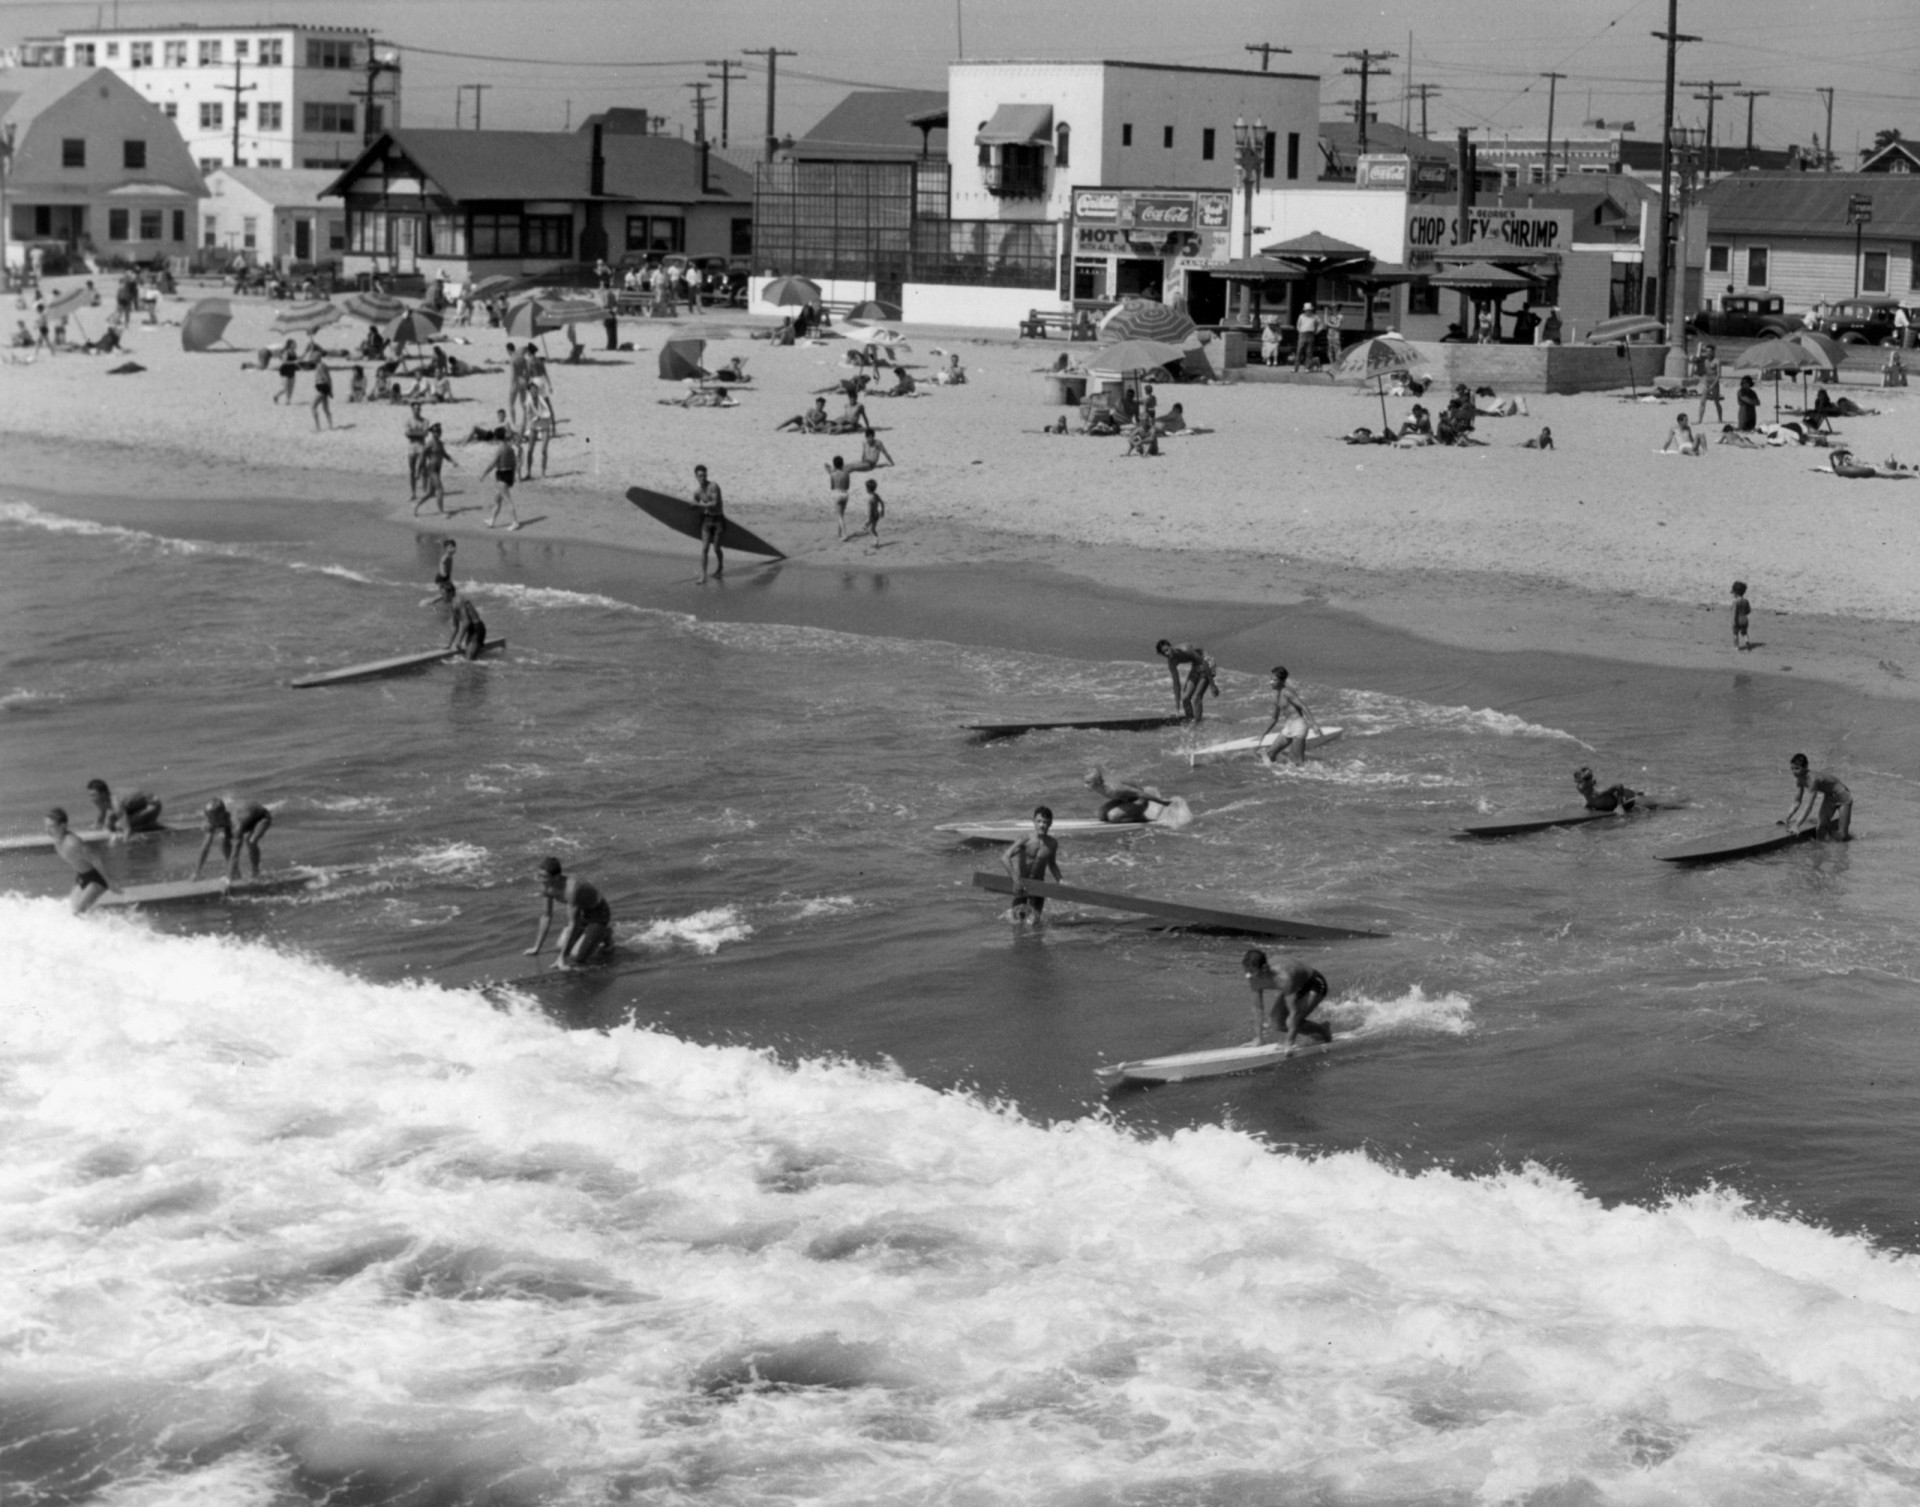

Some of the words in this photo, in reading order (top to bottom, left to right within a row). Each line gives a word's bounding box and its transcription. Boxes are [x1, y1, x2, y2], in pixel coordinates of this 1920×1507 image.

[1079, 229, 1118, 243] HOT
[1409, 216, 1446, 246] CHOP
[1501, 219, 1558, 248] SHRIMP
